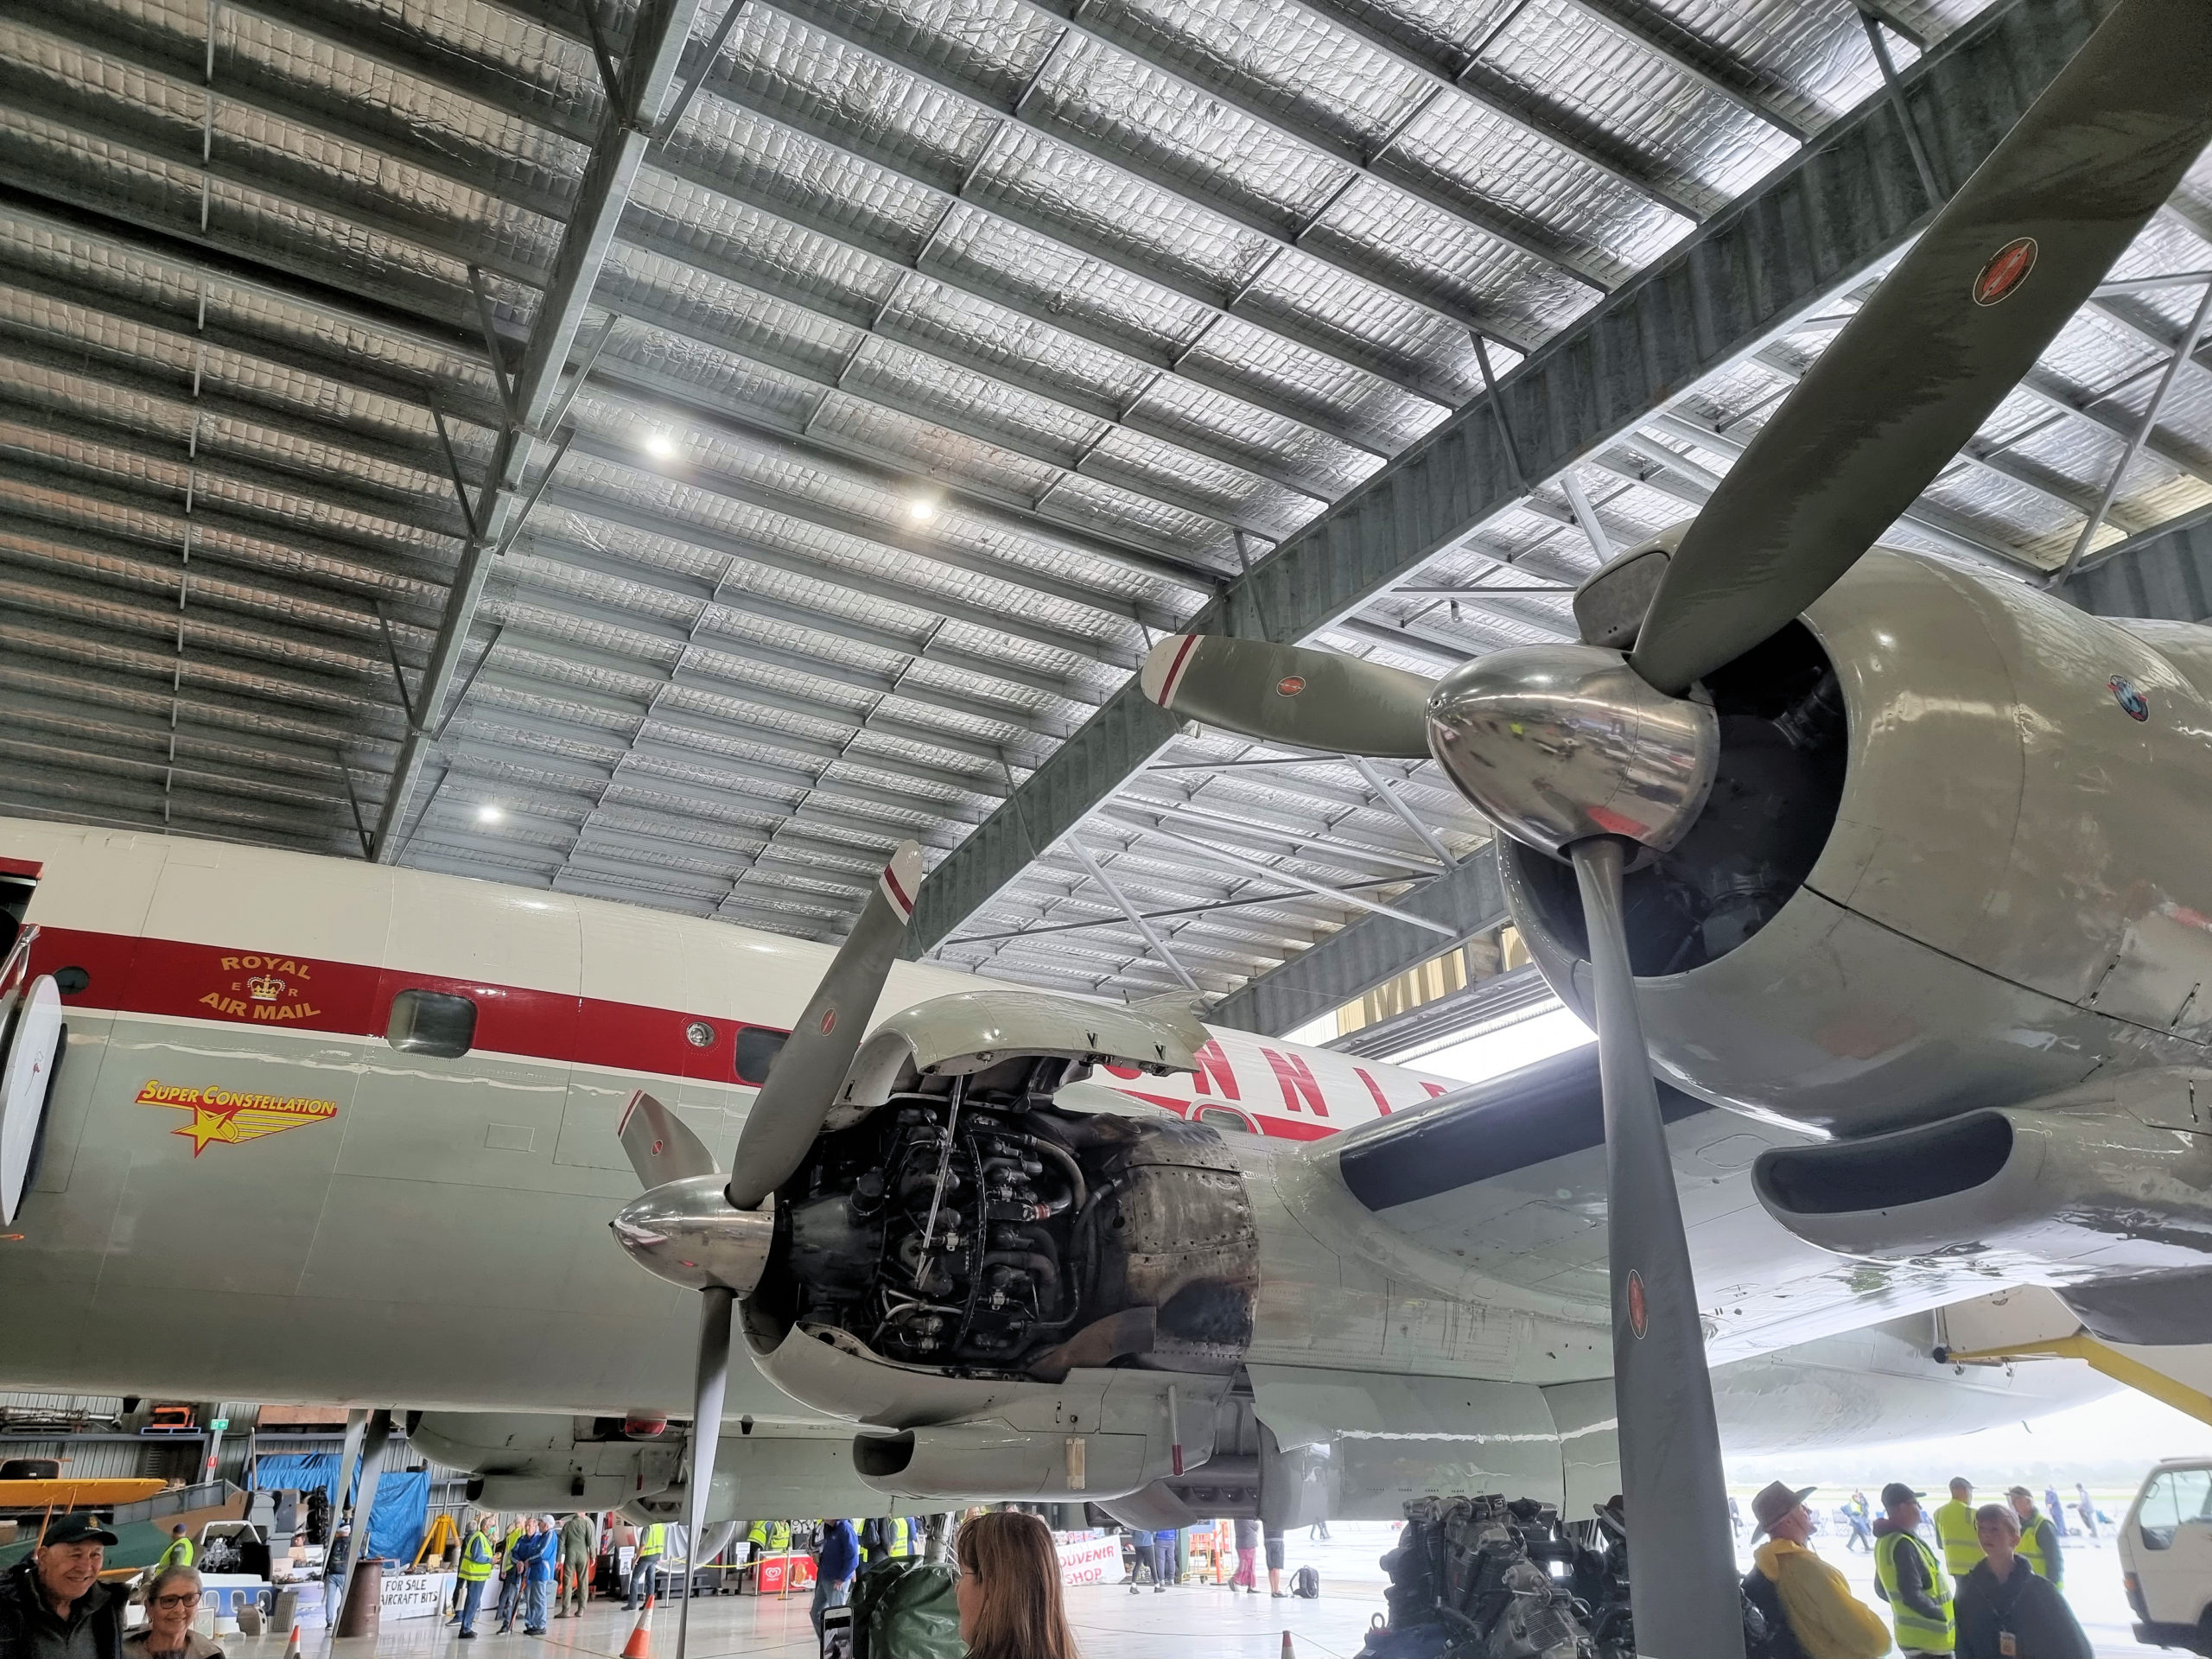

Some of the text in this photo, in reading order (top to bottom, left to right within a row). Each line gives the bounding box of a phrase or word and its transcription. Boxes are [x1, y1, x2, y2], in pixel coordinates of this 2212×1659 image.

[220, 956, 311, 980] ROYAL
[231, 982, 298, 997] E R
[199, 992, 321, 1020] AIR MAIL
[142, 1079, 336, 1115] SUPER CONSTELLATION
[1058, 1545, 1115, 1567] OUVENIR
[385, 1579, 427, 1592] FOR SALE
[1064, 1567, 1103, 1585] SHOP
[381, 1591, 438, 1605] AIRCRAFT BITS
